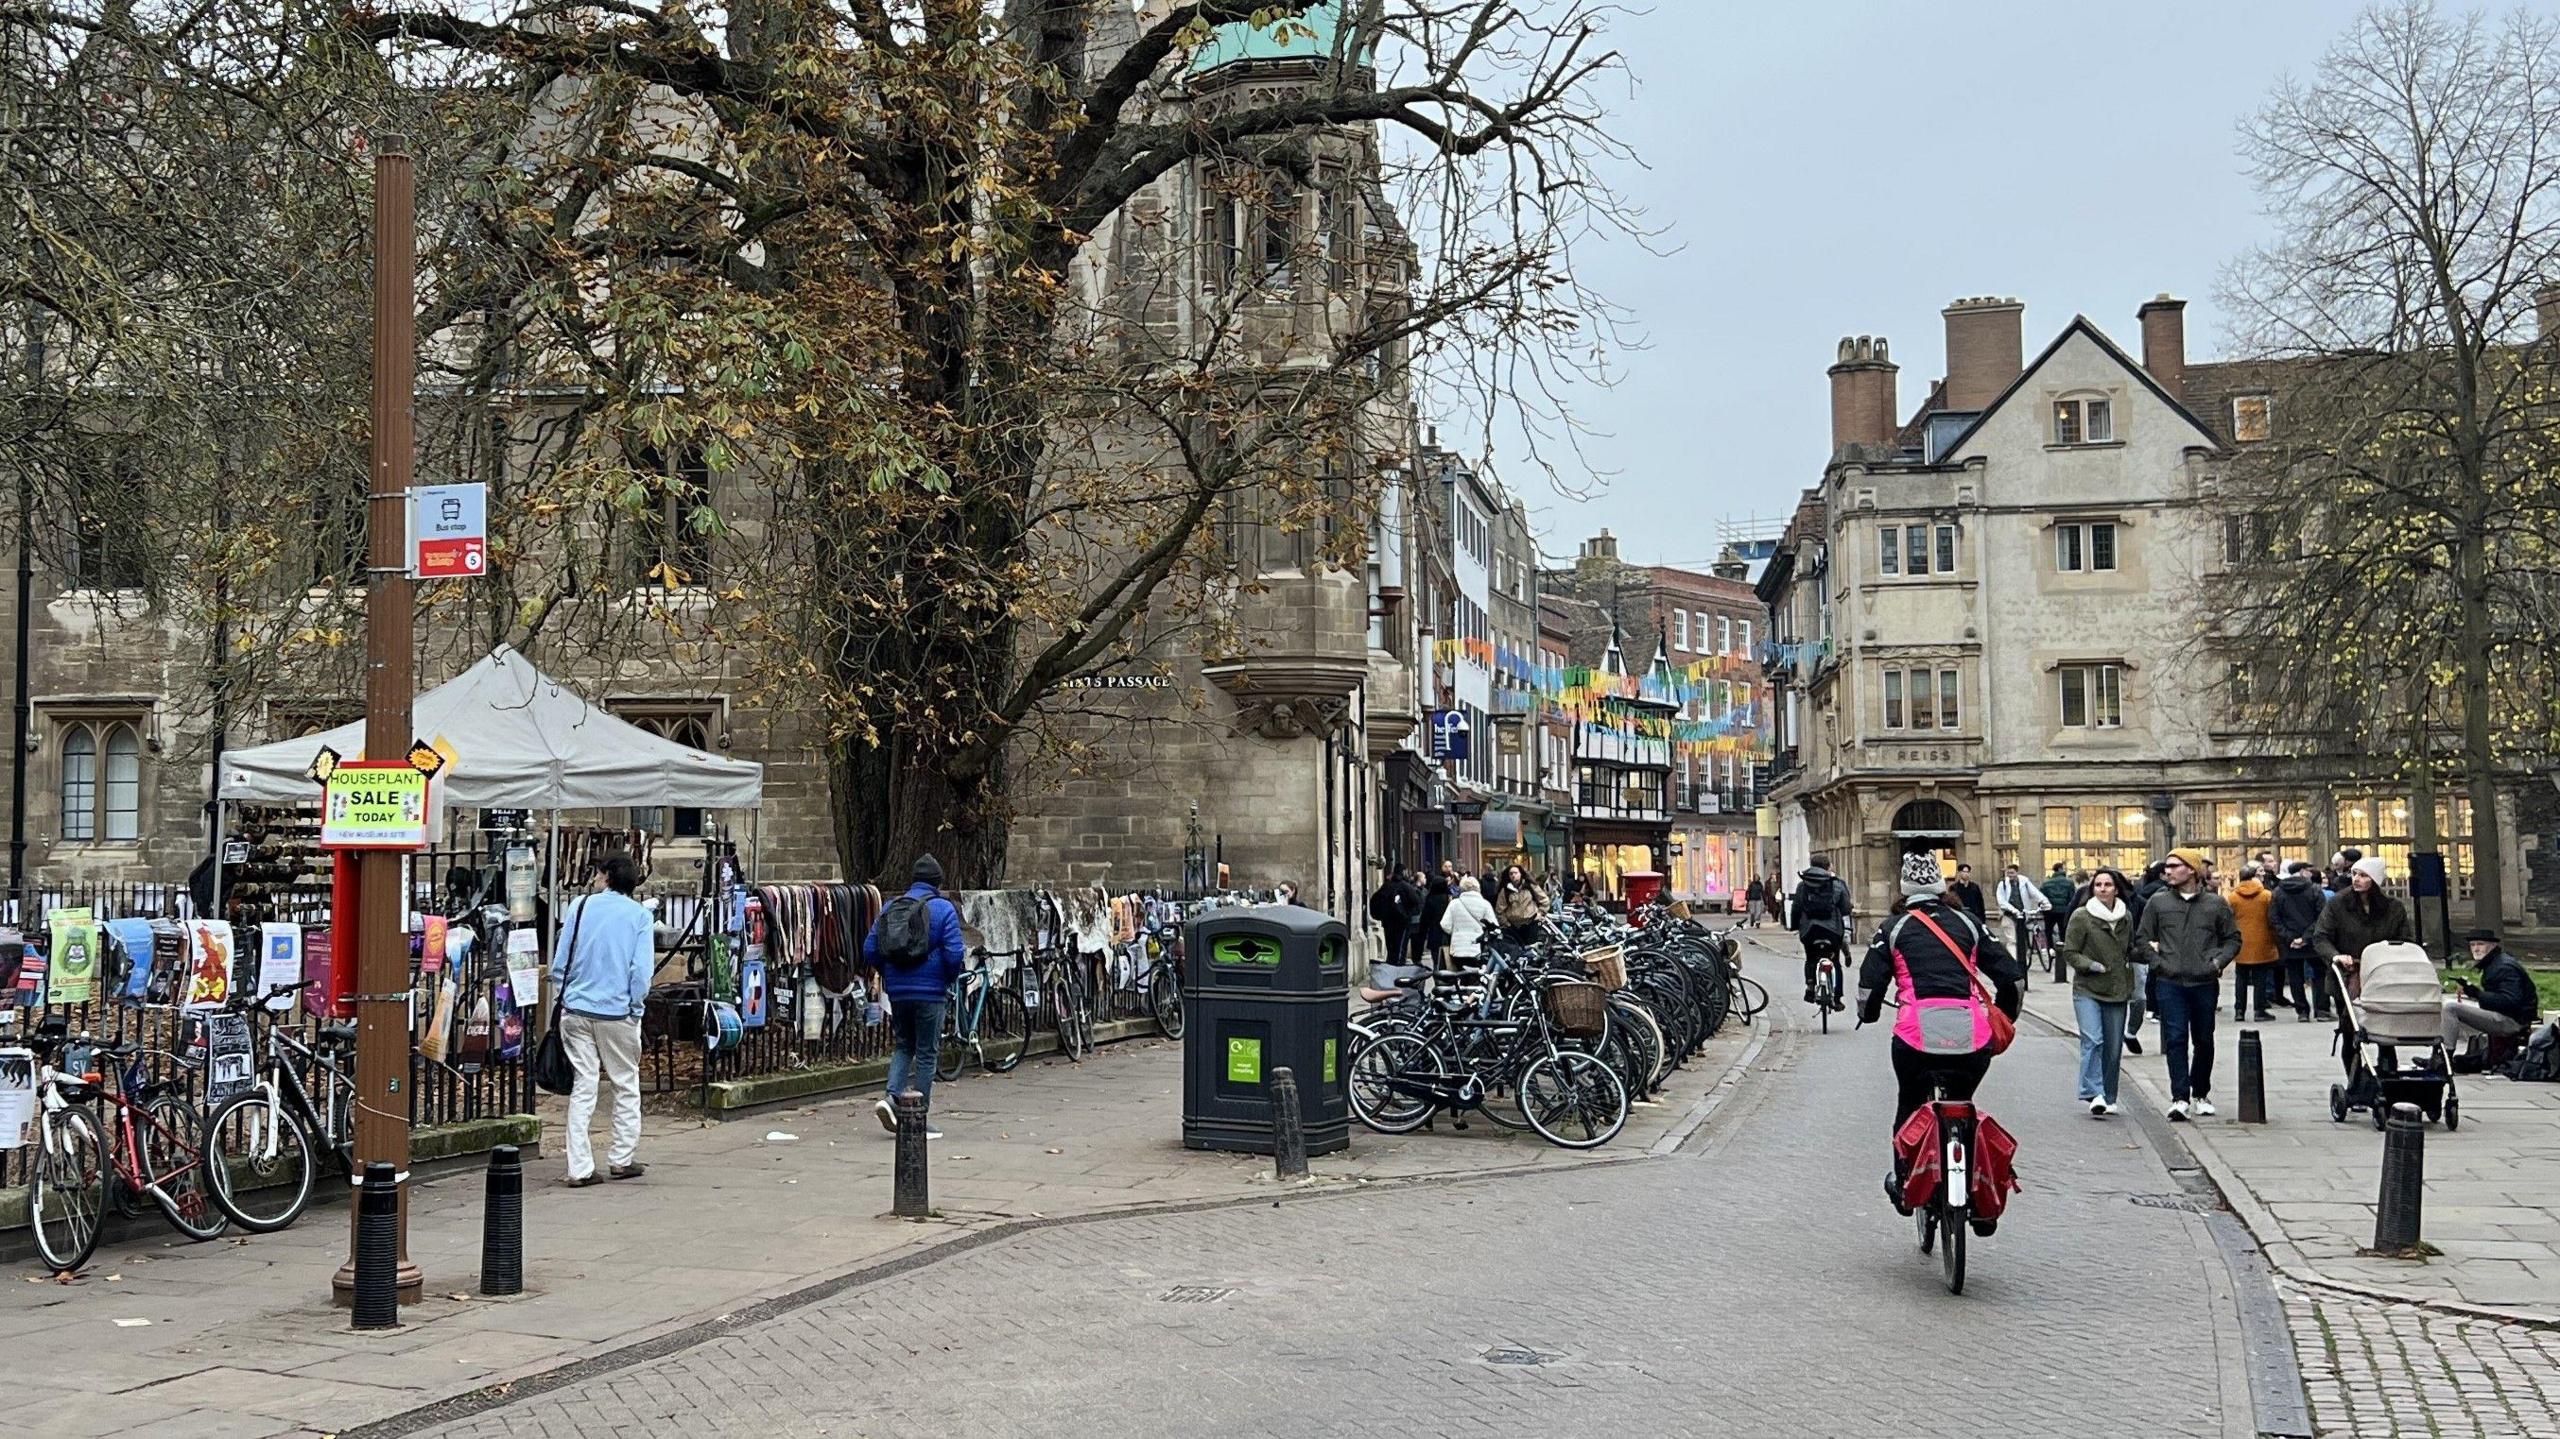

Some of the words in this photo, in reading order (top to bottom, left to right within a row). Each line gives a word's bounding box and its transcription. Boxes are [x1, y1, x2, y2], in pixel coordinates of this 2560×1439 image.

[436, 524, 449, 532] Bus
[450, 524, 466, 532] stop
[1107, 676, 1170, 688] PASSAGE
[1898, 750, 1951, 761] REISS
[331, 773, 422, 785] HOUSEPLANT
[350, 791, 400, 805] SALE
[354, 812, 395, 823] TODAY
